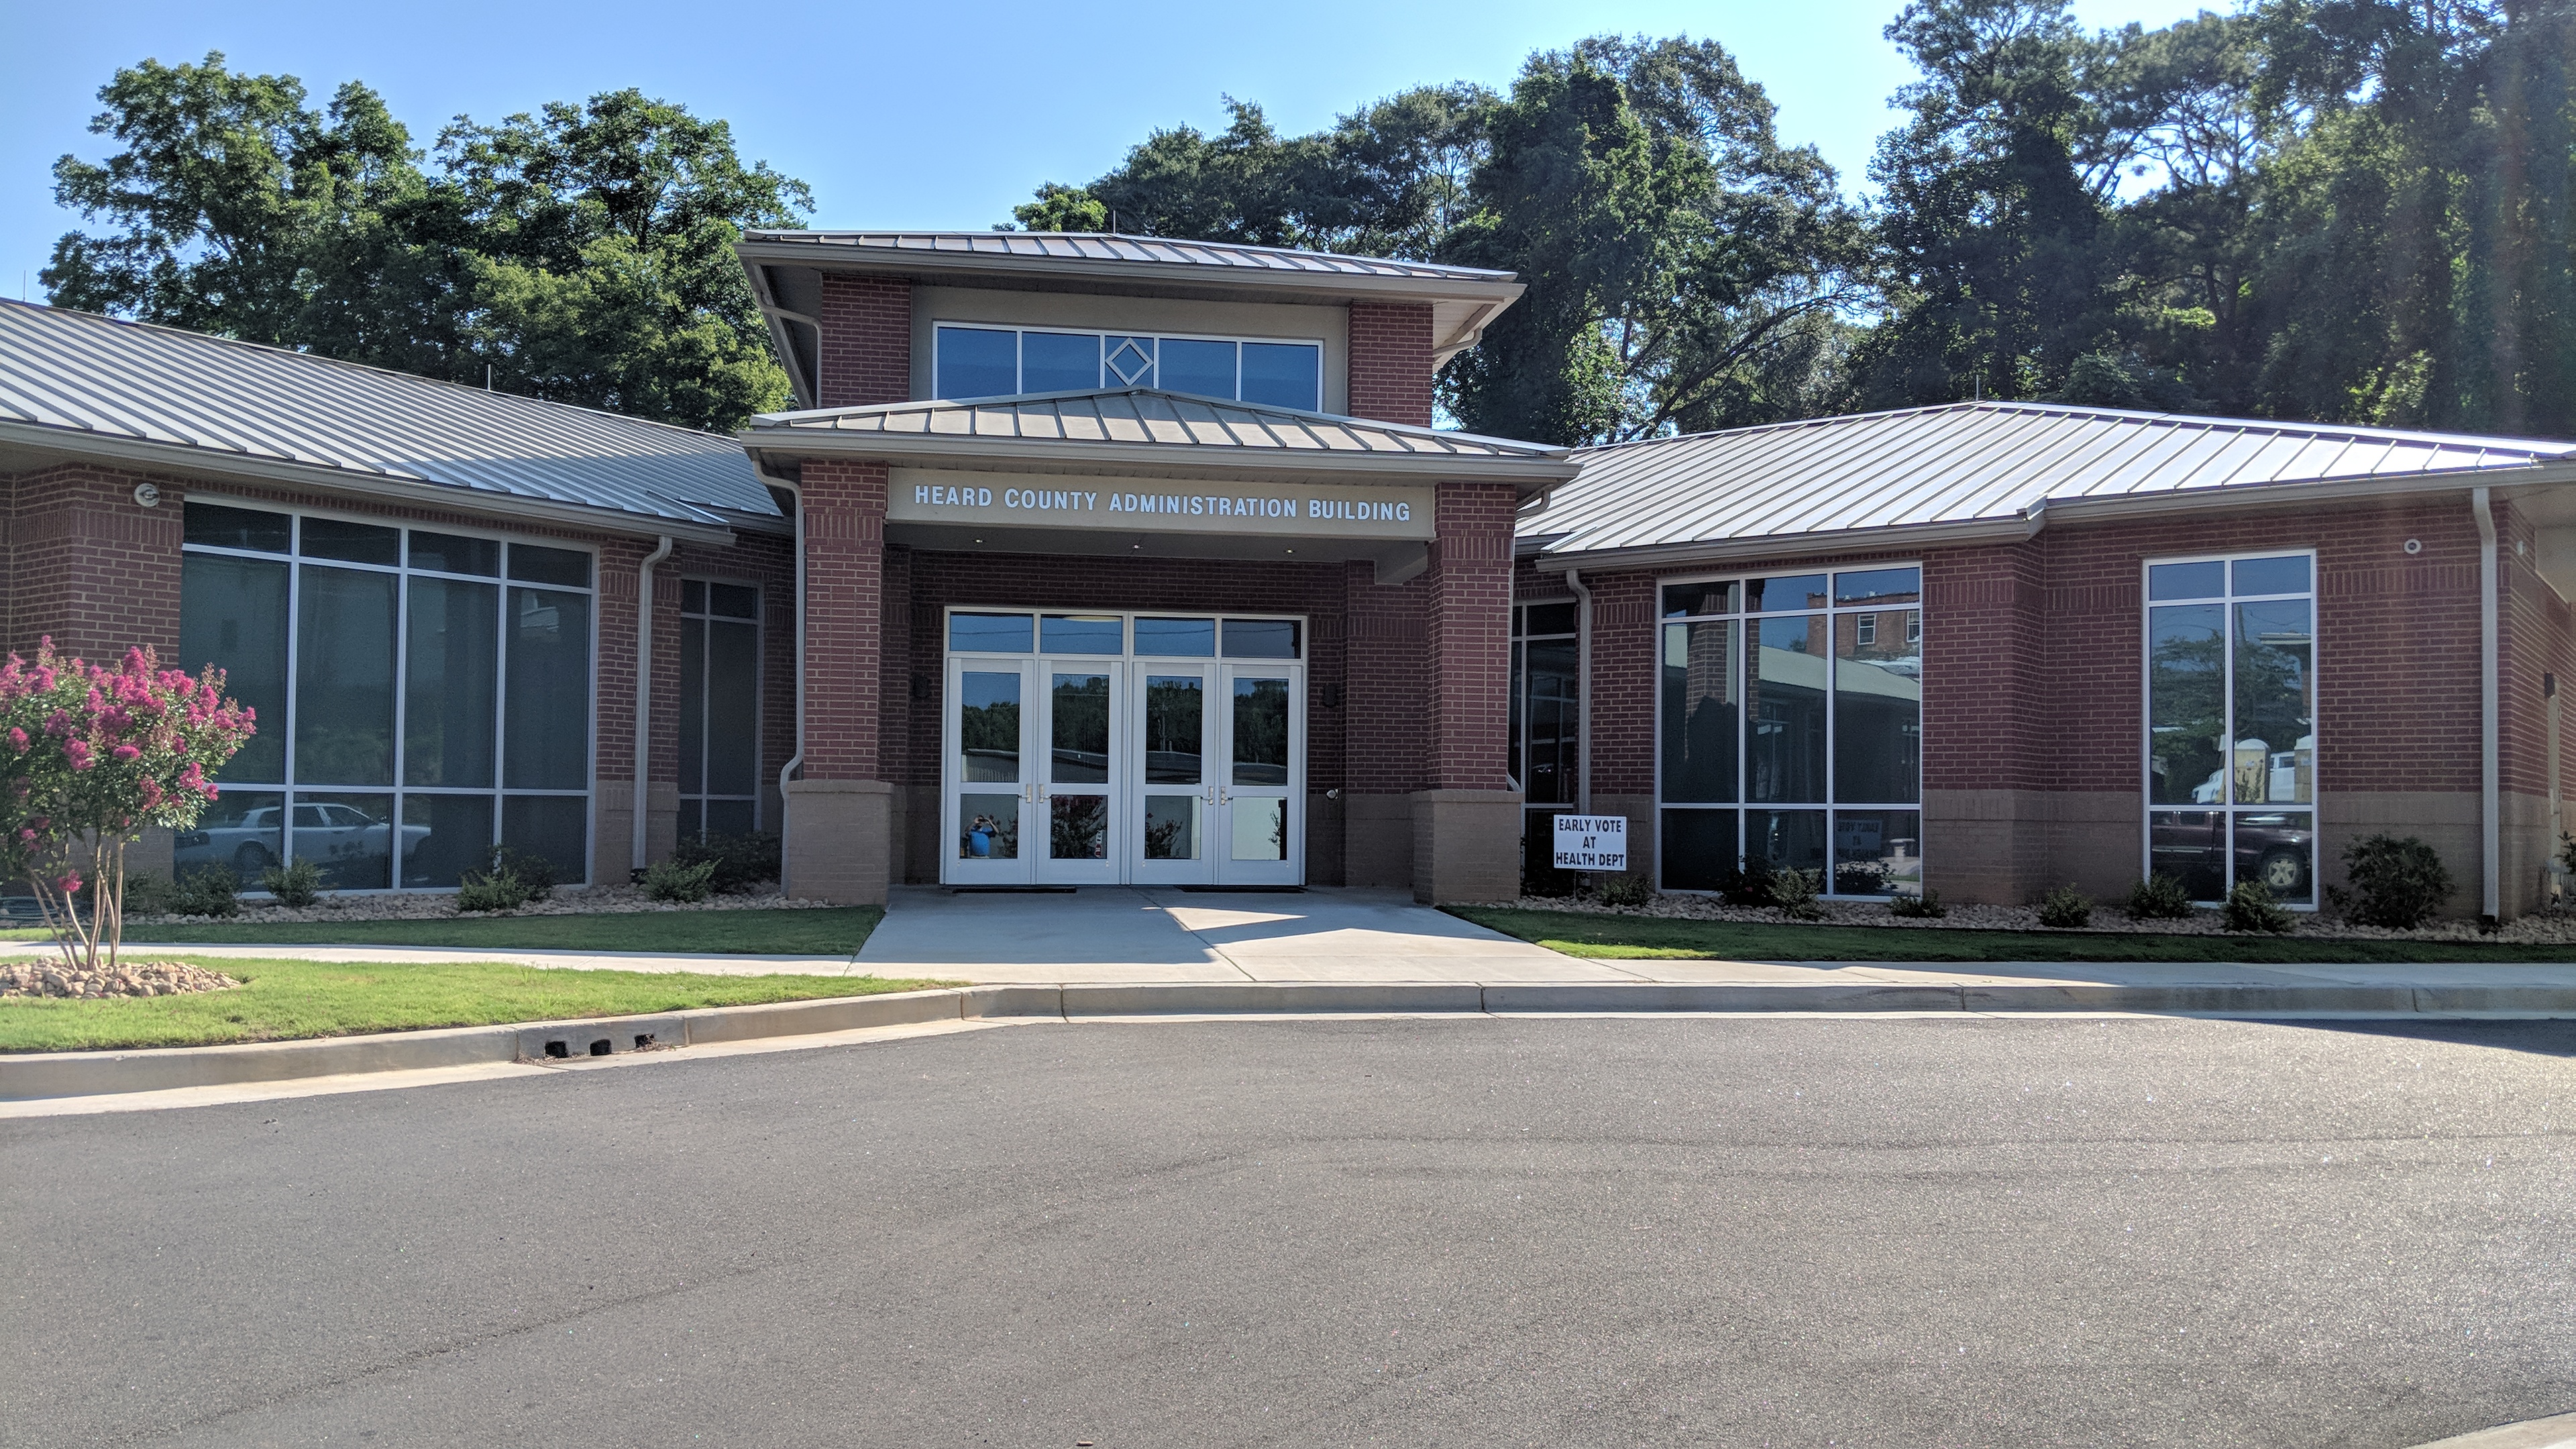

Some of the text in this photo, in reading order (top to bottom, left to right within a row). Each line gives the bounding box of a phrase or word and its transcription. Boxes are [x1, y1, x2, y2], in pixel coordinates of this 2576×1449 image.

[915, 485, 1410, 521] HEARD COUNTY ADMINISTRATION BUILDING
[1558, 818, 1621, 833] EARLY VOTE
[1582, 836, 1597, 849] AT
[1556, 852, 1624, 867] HEALTH DEPT
